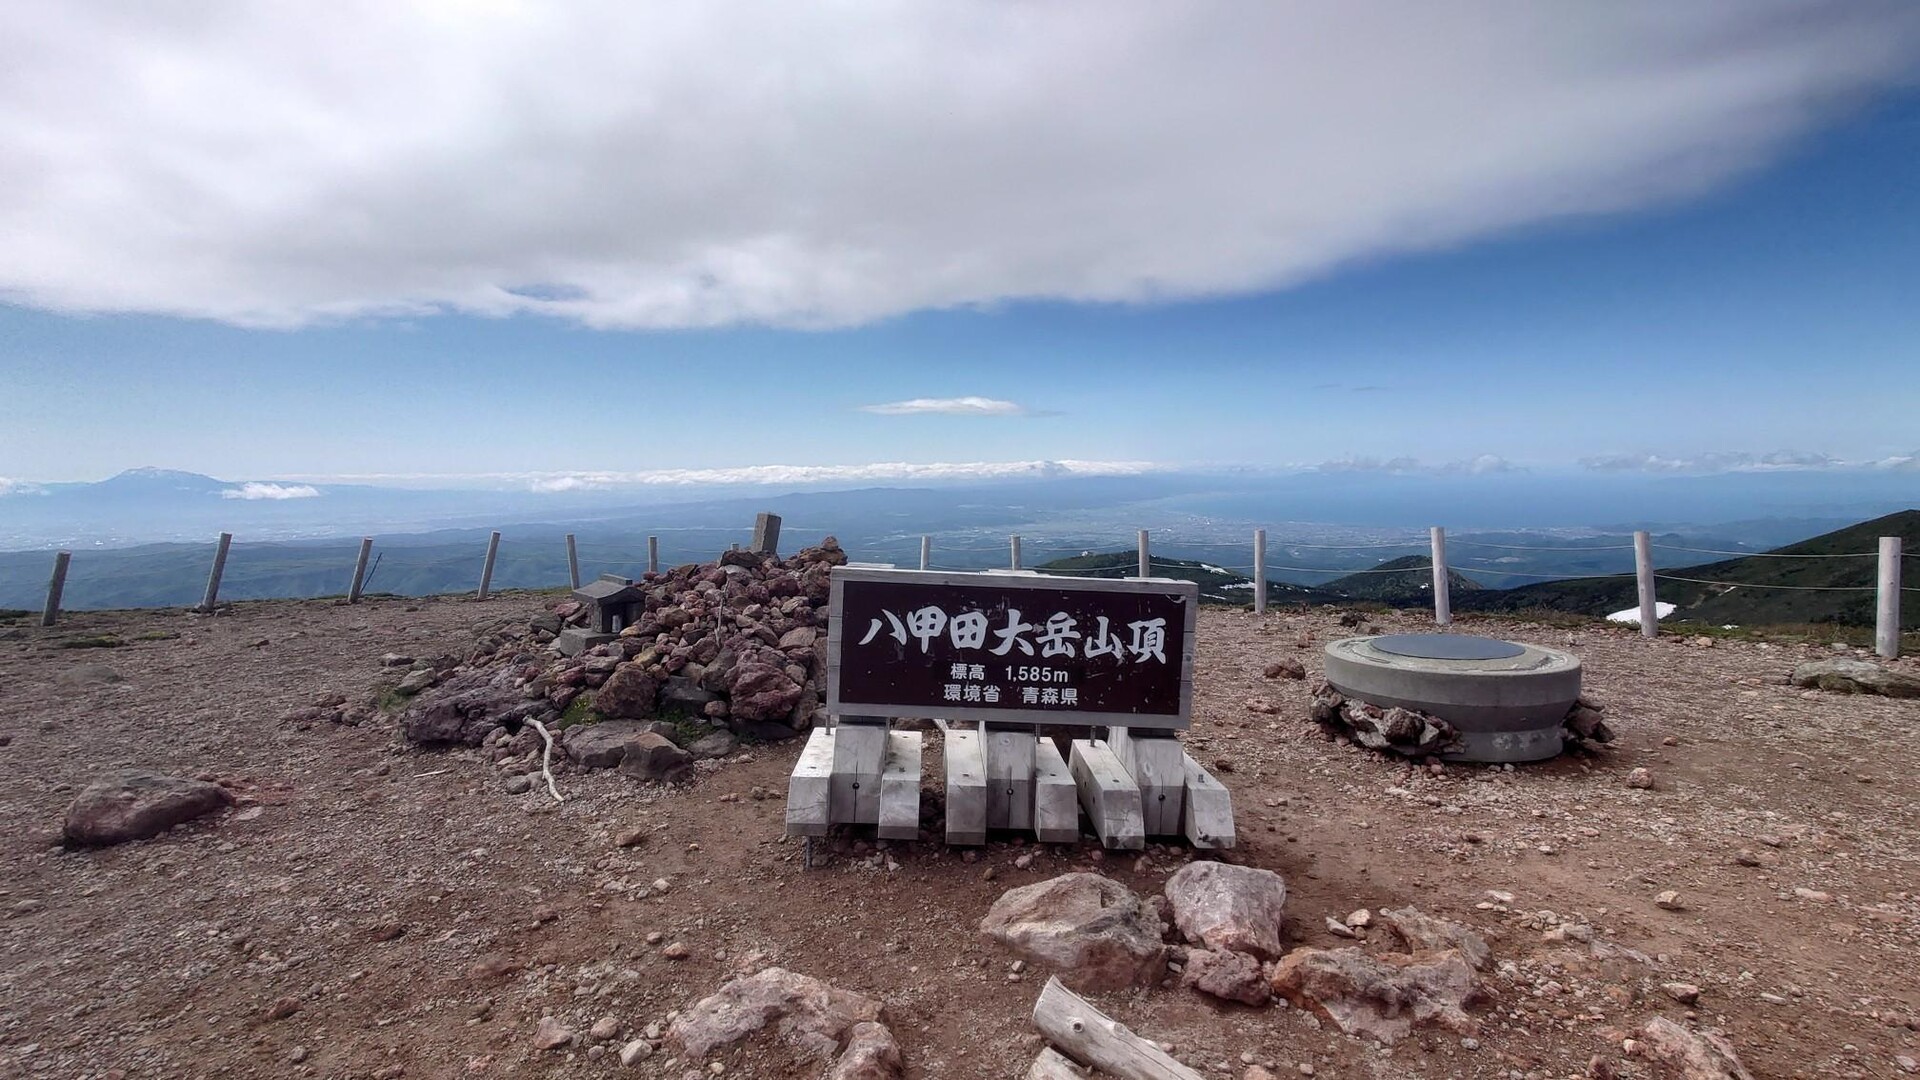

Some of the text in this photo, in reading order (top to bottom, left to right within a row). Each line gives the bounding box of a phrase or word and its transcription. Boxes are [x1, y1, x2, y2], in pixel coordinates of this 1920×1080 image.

[858, 605, 1167, 664] 八甲田大岳山頂
[950, 662, 1069, 683] 標高 1,585m
[943, 684, 1078, 706] 環境省 青森県
